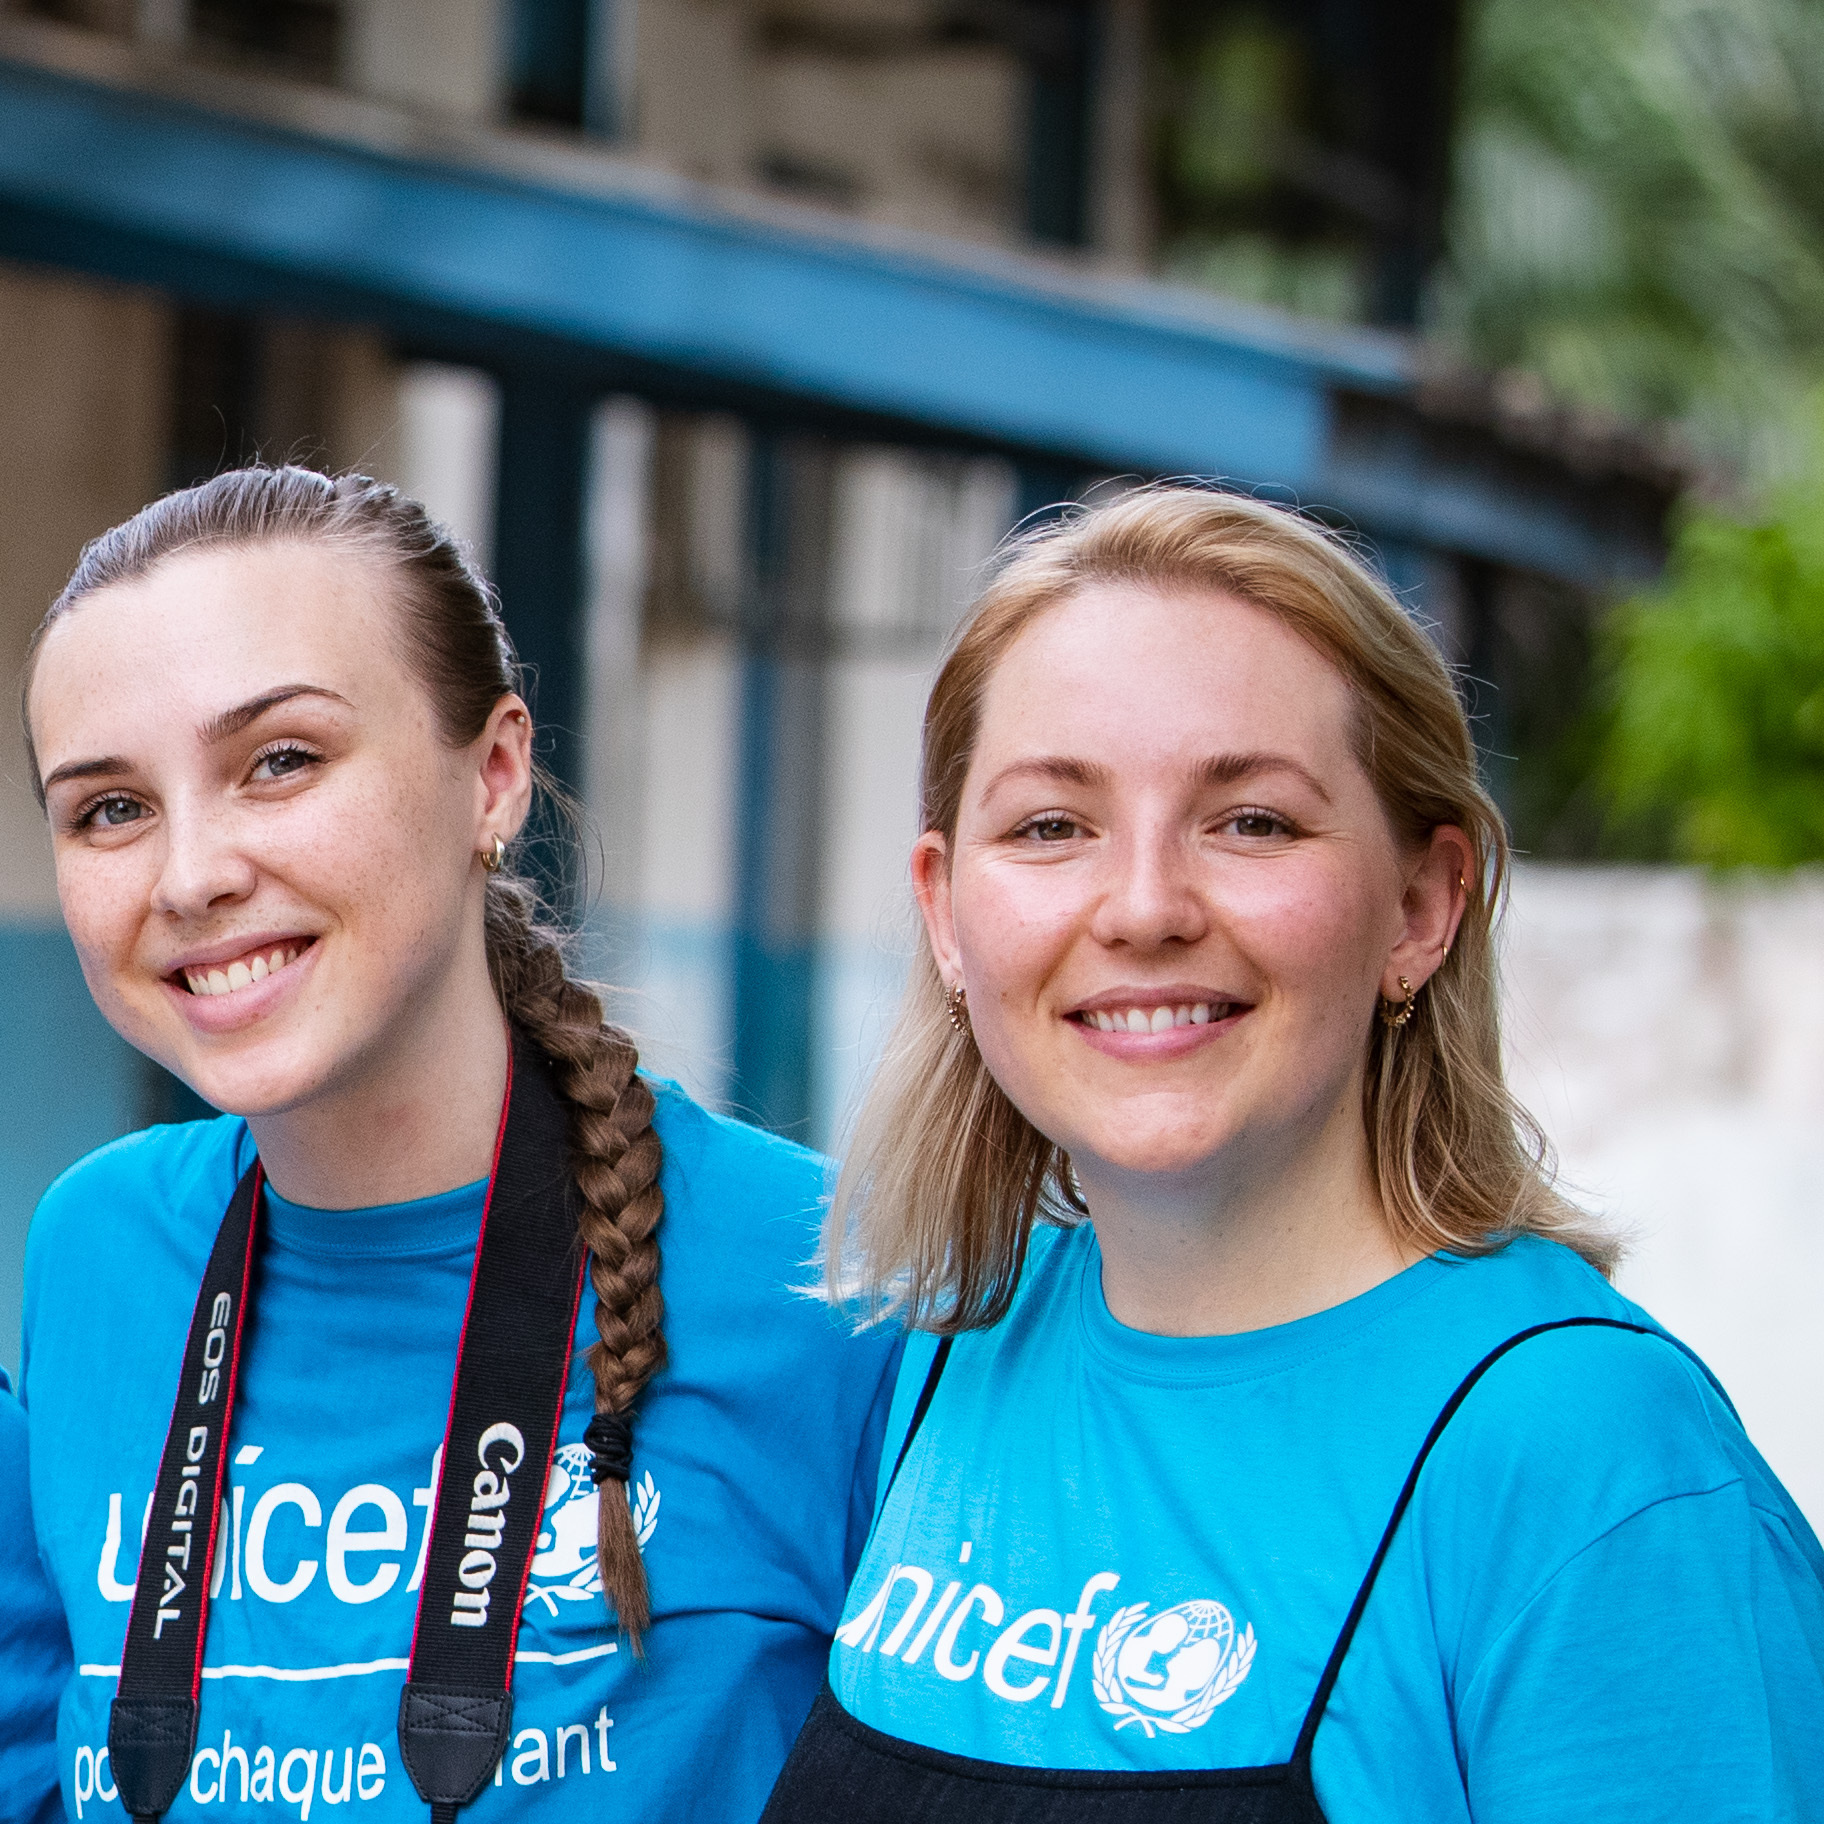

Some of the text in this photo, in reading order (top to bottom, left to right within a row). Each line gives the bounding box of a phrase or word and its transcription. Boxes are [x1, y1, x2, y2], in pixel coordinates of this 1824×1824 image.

[152, 1291, 232, 1640] EOS DIGITAL
[450, 1421, 525, 1627] Canon
[190, 1729, 386, 1822] chaque
